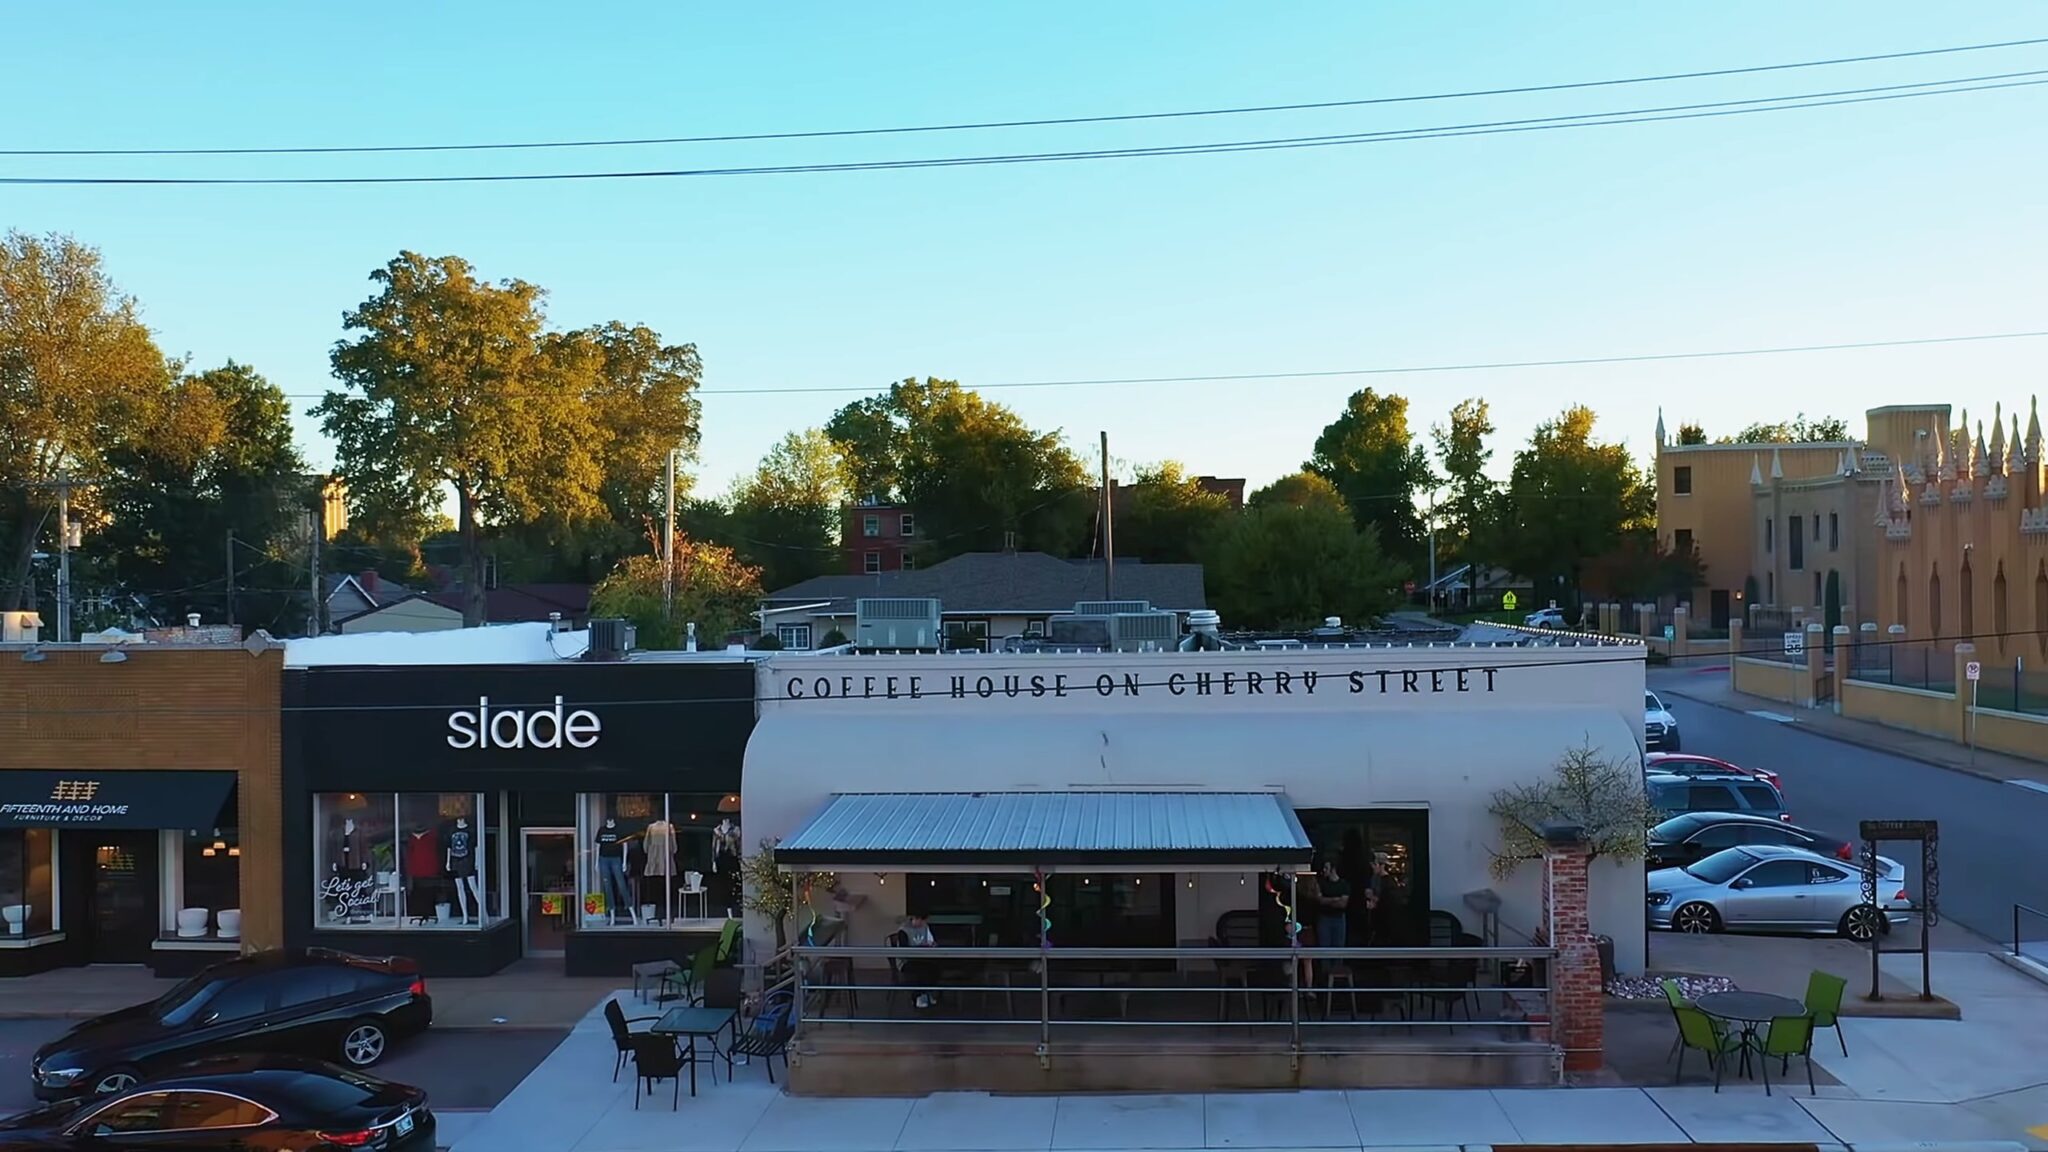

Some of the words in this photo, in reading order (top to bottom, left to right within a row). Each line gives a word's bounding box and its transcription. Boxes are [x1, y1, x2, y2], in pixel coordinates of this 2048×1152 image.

[1786, 644, 1802, 653] 25
[786, 676, 923, 699] COFFEE
[950, 674, 1068, 698] HOUSE
[1096, 673, 1140, 697] ON
[1168, 671, 1318, 695] CHERRY
[1349, 668, 1499, 693] STREET
[446, 695, 602, 749] slade
[0, 804, 61, 814] FIFTEENTH
[62, 805, 90, 814] AND
[91, 805, 129, 815] HOME
[14, 814, 61, 822] FURNITURE
[320, 876, 352, 900] Let's
[350, 874, 374, 898] get
